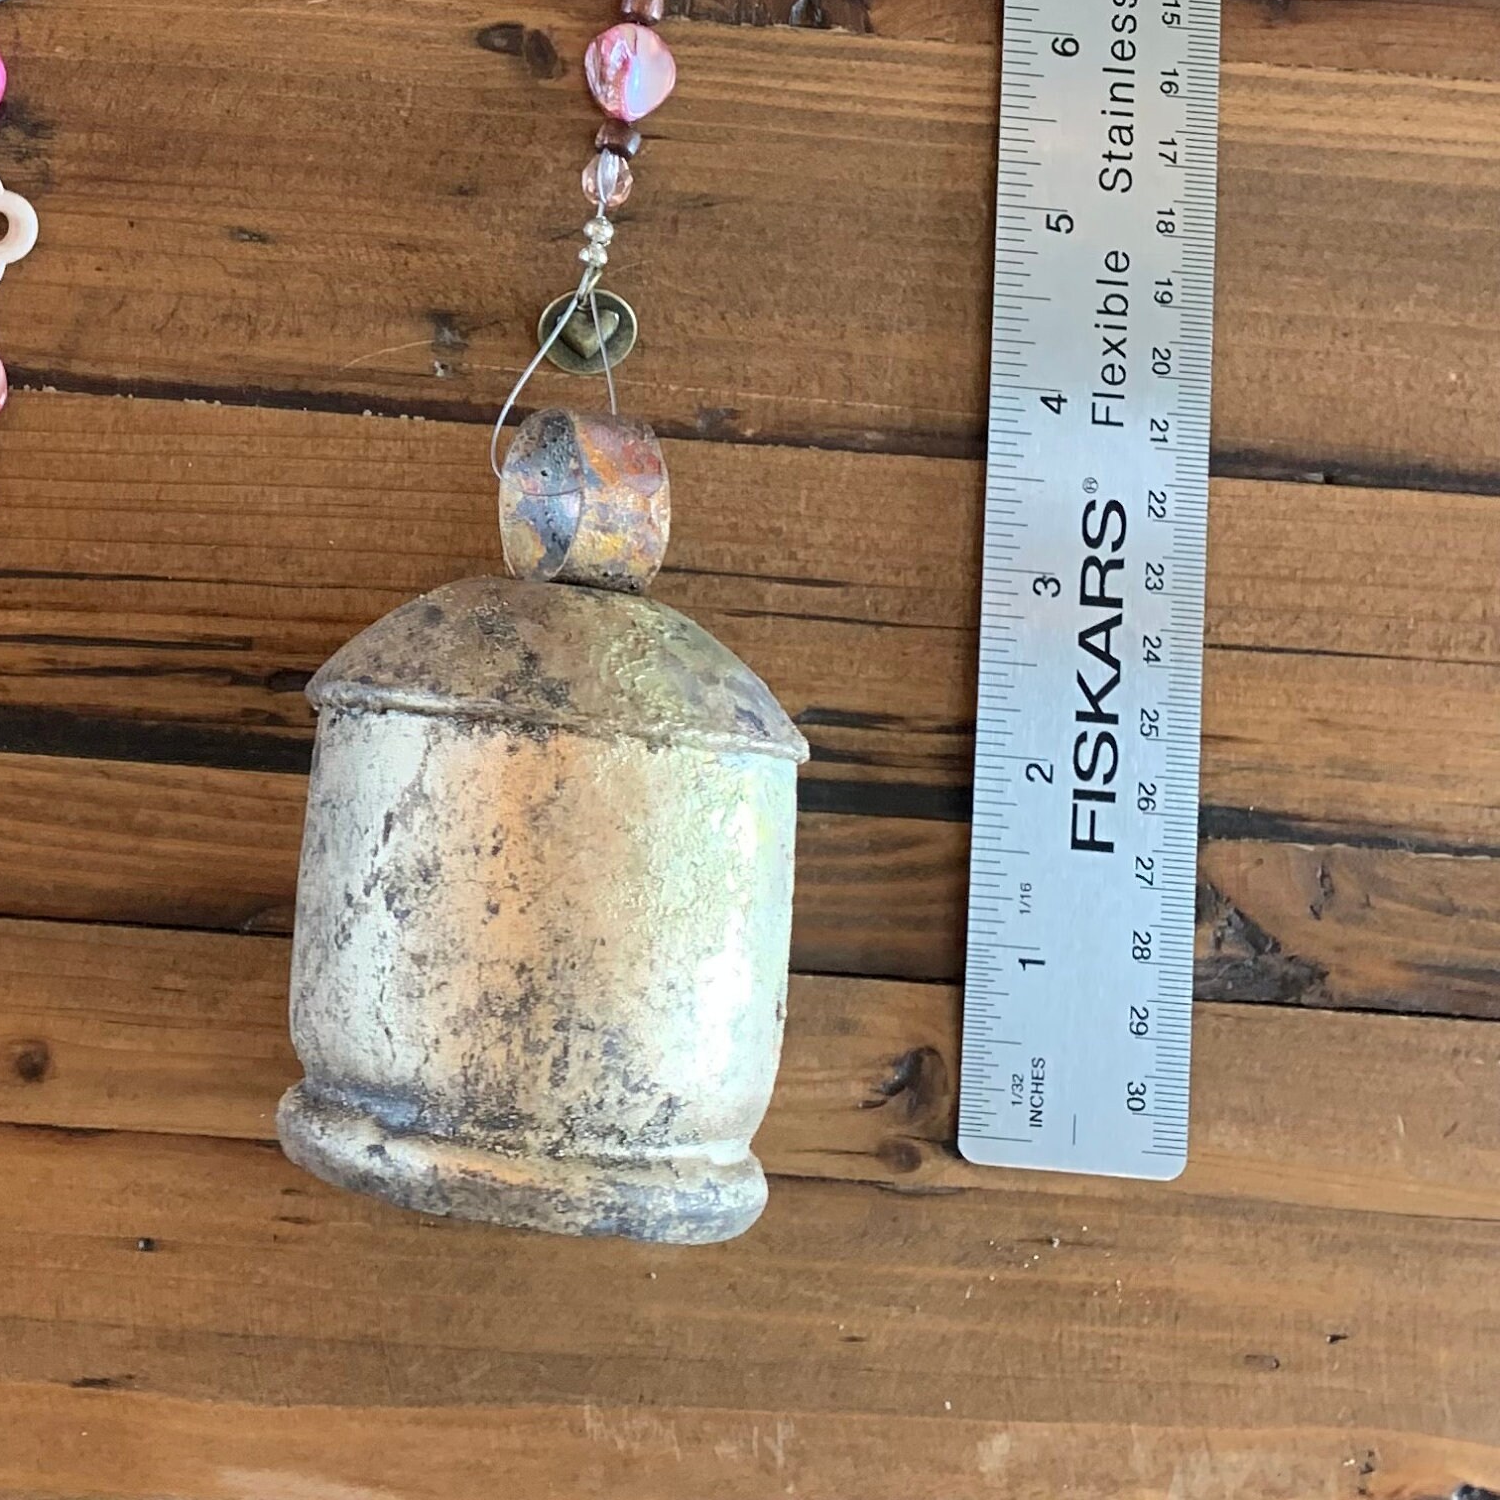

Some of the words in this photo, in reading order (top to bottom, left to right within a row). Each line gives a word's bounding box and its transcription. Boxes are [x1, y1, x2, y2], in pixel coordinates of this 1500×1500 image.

[1162, 0, 1180, 25] 15
[1051, 37, 1079, 57] 6
[1160, 69, 1178, 94] 16
[1158, 138, 1177, 164] 17
[1046, 214, 1073, 234] 5
[1156, 208, 1175, 234] 18
[1154, 279, 1173, 304] 19
[1091, 250, 1130, 427] Flexible
[1151, 348, 1170, 375] 20
[1040, 394, 1067, 415] 4
[1150, 419, 1169, 444] 21
[1147, 490, 1167, 519] 22
[1033, 576, 1061, 597] 3
[1145, 562, 1164, 591] 23
[1142, 636, 1162, 663] 24
[1140, 708, 1159, 738] 25
[1025, 763, 1053, 784] 2
[1137, 783, 1156, 812] 26
[1135, 857, 1154, 886] 27
[1020, 883, 1032, 915] 1/16
[1132, 931, 1151, 961] 28
[1018, 958, 1046, 971] 1
[1129, 1007, 1149, 1035] 29
[1011, 1074, 1024, 1107] 1/32
[1030, 1057, 1046, 1127] INCHES
[1127, 1082, 1146, 1112] 30
